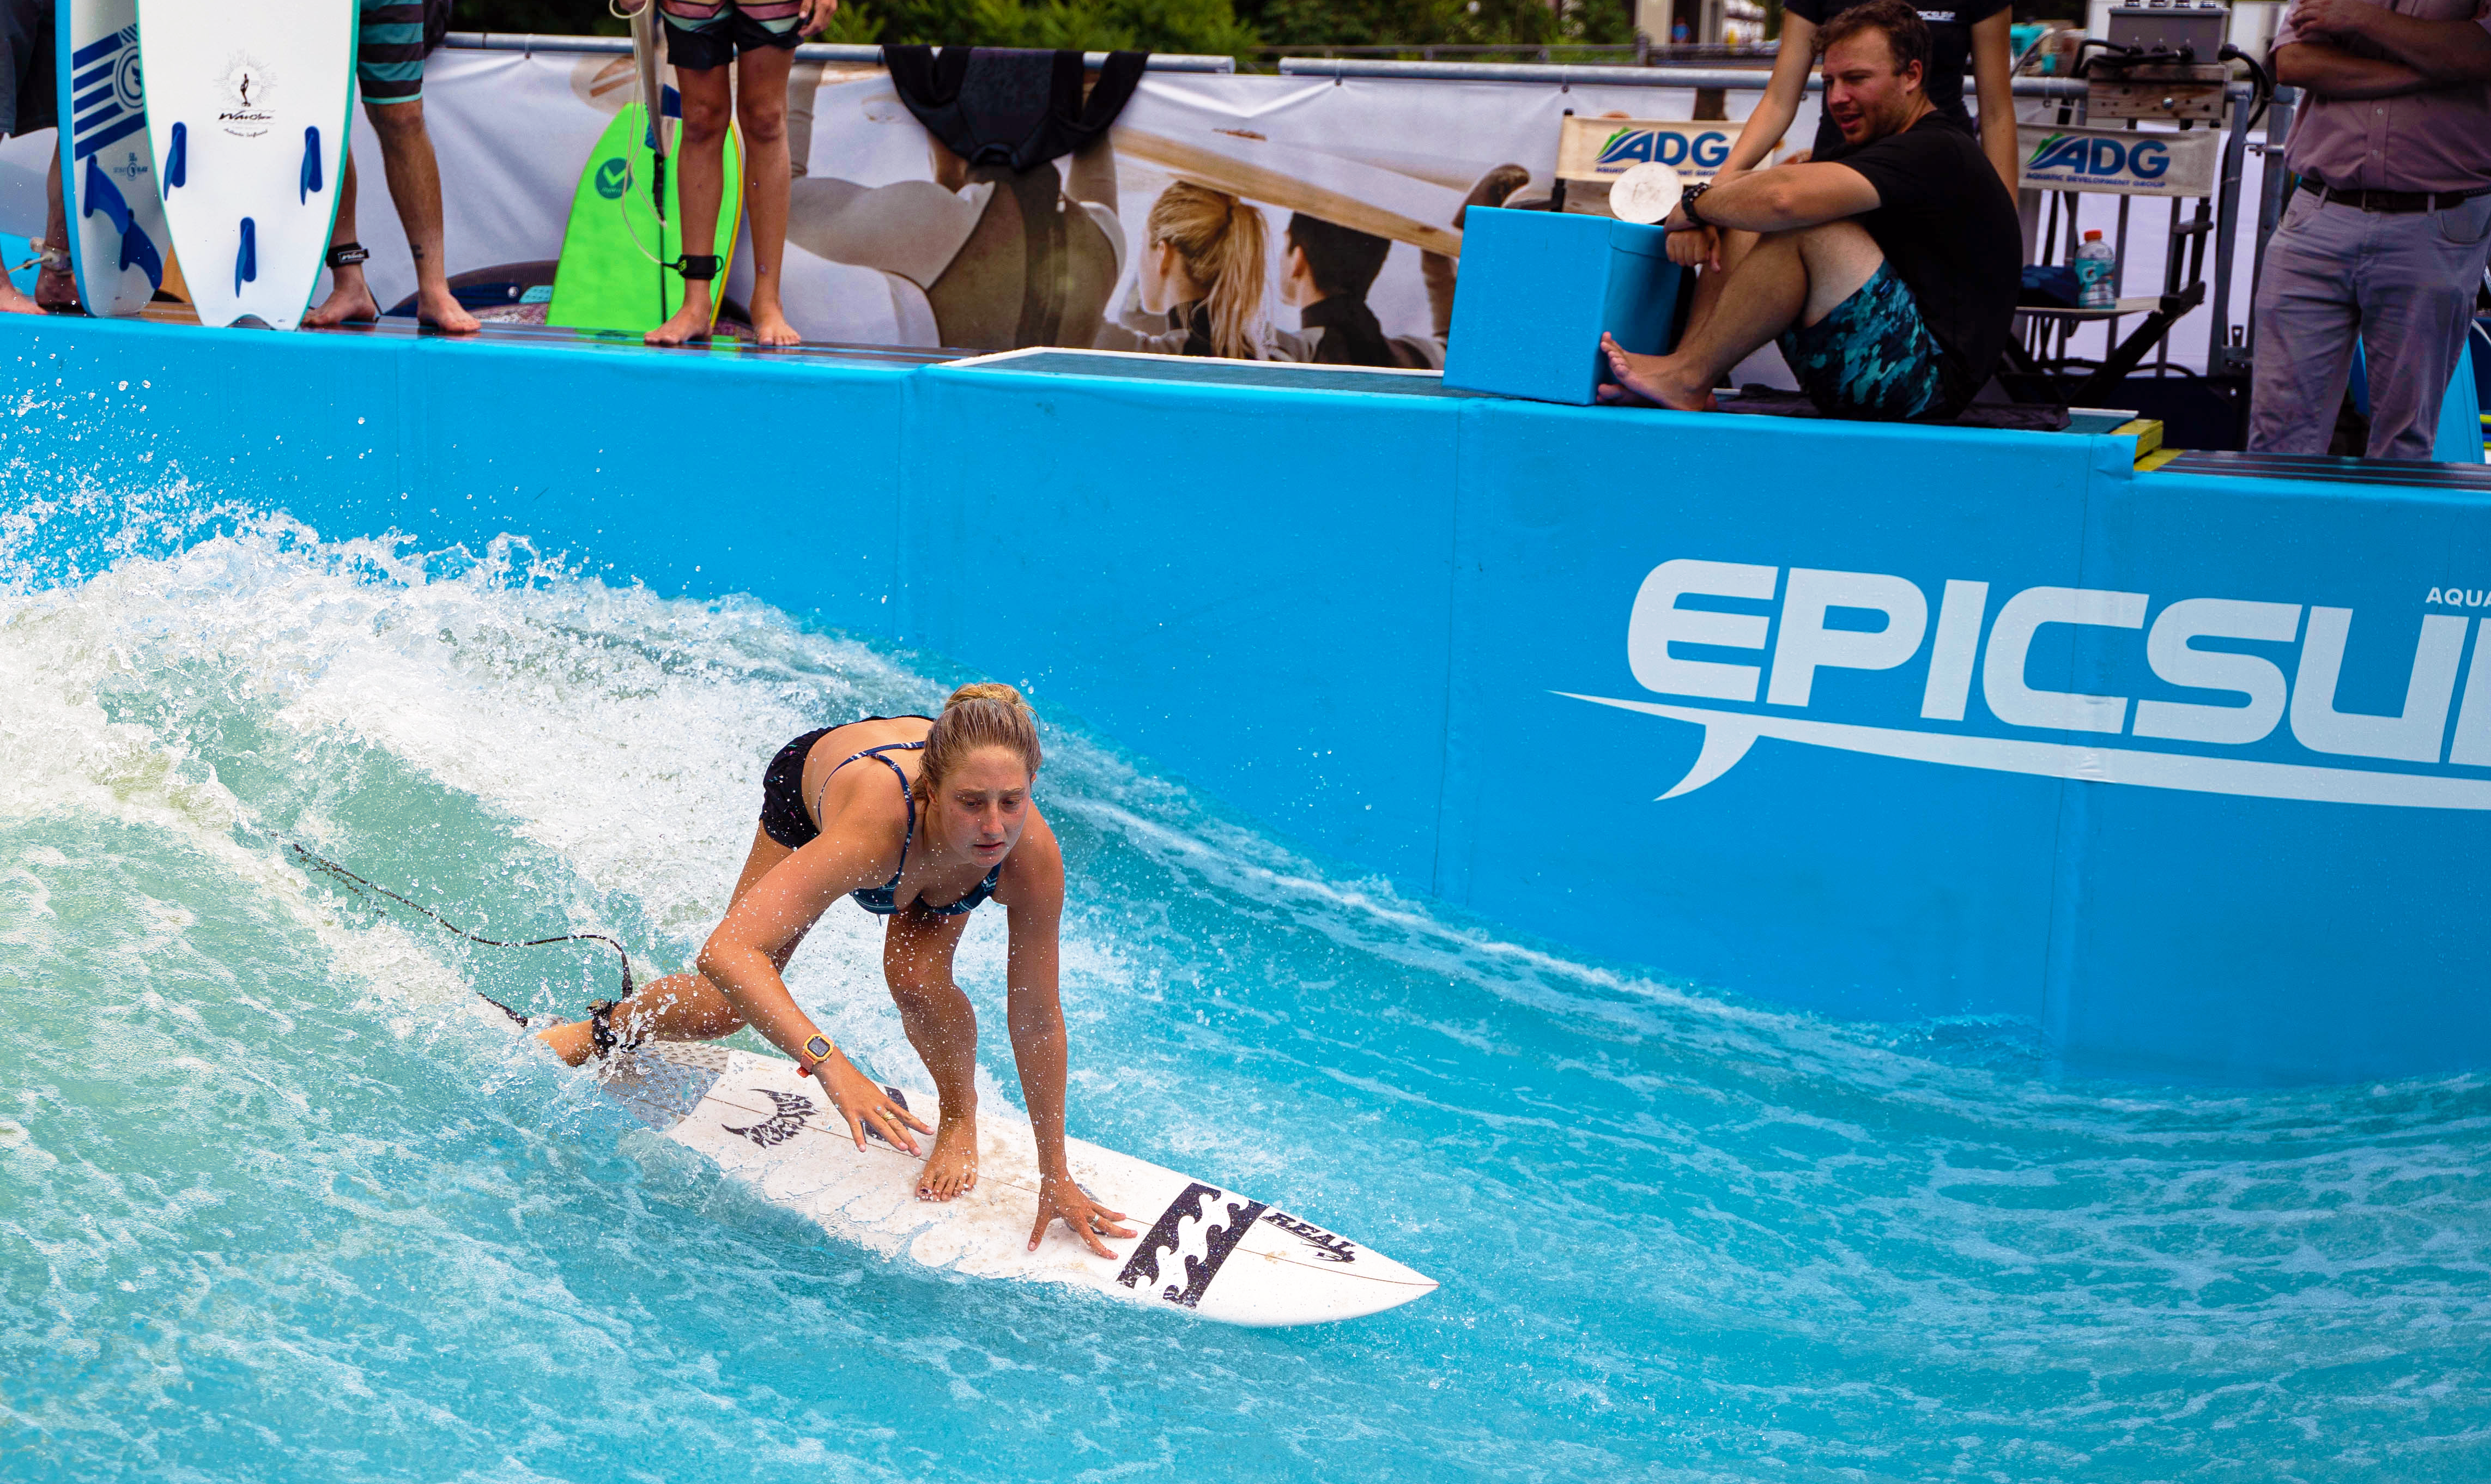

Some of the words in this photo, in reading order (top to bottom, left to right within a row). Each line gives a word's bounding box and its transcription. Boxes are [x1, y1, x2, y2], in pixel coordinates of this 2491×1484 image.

[1595, 130, 1730, 167] ADG
[2026, 136, 2170, 179] ADG
[2026, 172, 2063, 181] AQUATIC
[2066, 175, 2130, 186] DEVELOPMENT
[1627, 559, 2491, 765] EPICSU
[1262, 1212, 1356, 1255] REAL
